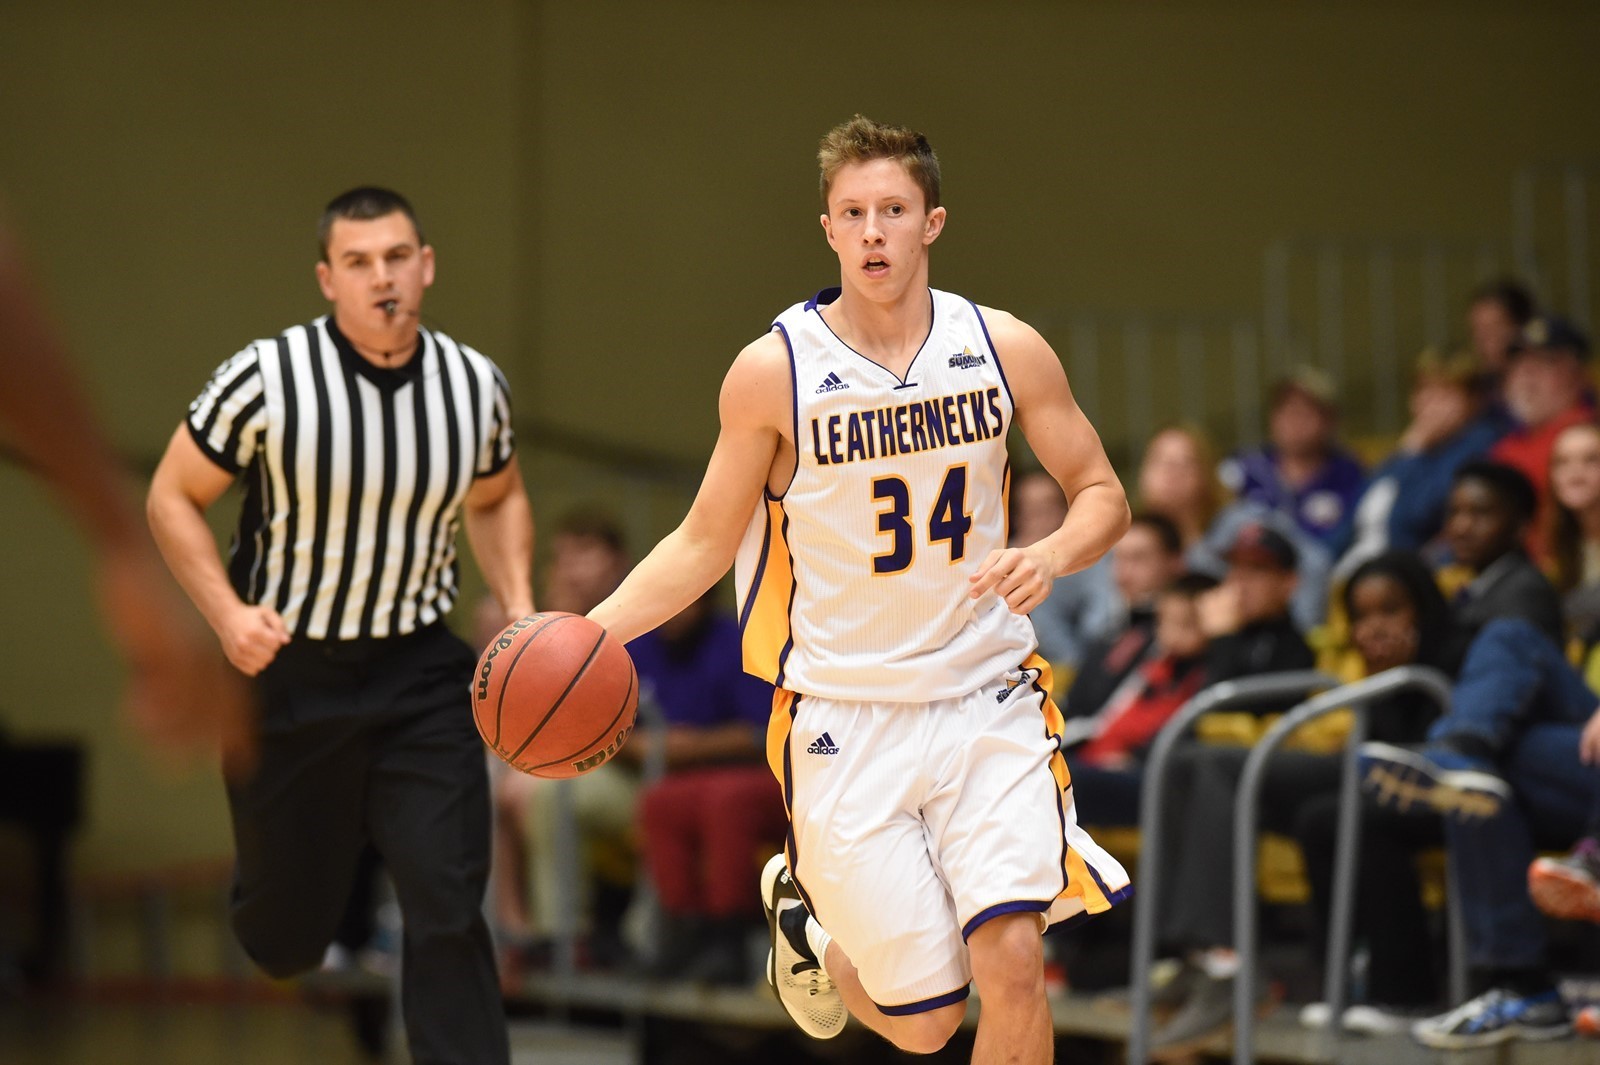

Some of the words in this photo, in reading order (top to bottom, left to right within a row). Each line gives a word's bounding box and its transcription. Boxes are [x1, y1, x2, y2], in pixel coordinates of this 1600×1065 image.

[815, 383, 850, 394] adidas
[811, 386, 1003, 466] LEATHERNECKS
[870, 461, 974, 577] 34
[806, 746, 840, 755] adidas
